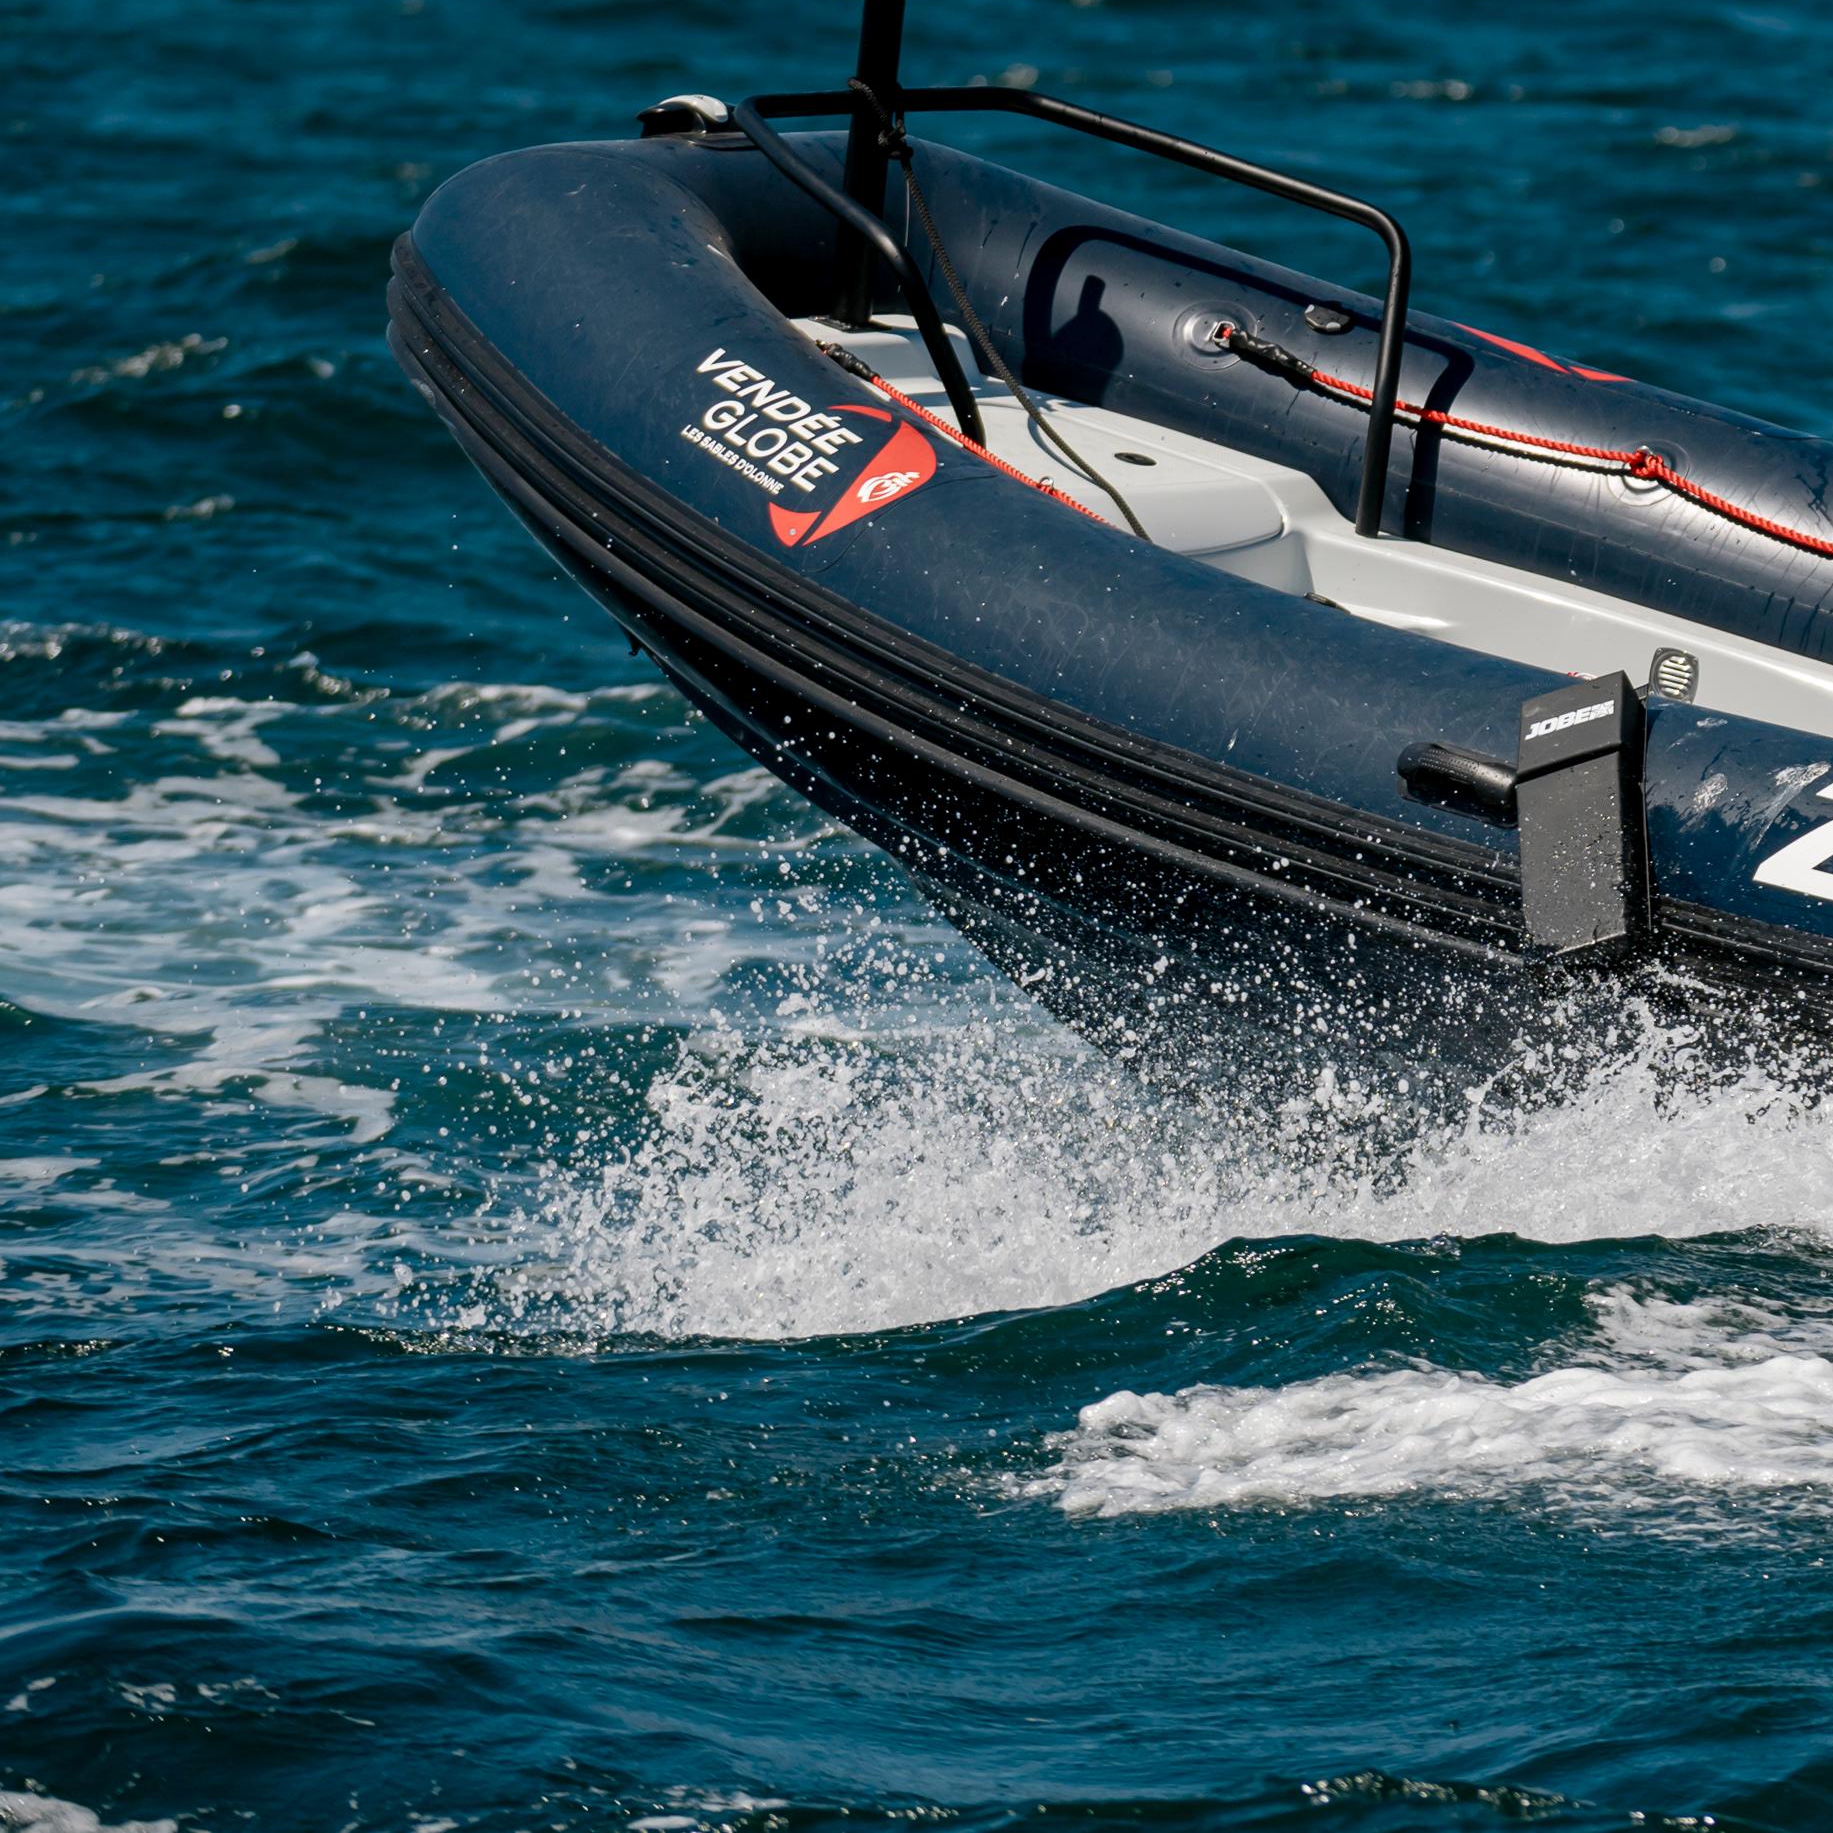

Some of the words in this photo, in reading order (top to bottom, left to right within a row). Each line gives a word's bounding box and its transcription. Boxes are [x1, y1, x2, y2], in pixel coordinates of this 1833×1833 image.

[696, 347, 864, 456] VENDÉE
[703, 400, 840, 493] GLOBE
[680, 424, 705, 443] LES
[700, 436, 739, 467] SABLES
[734, 458, 785, 496] D'OLONNE
